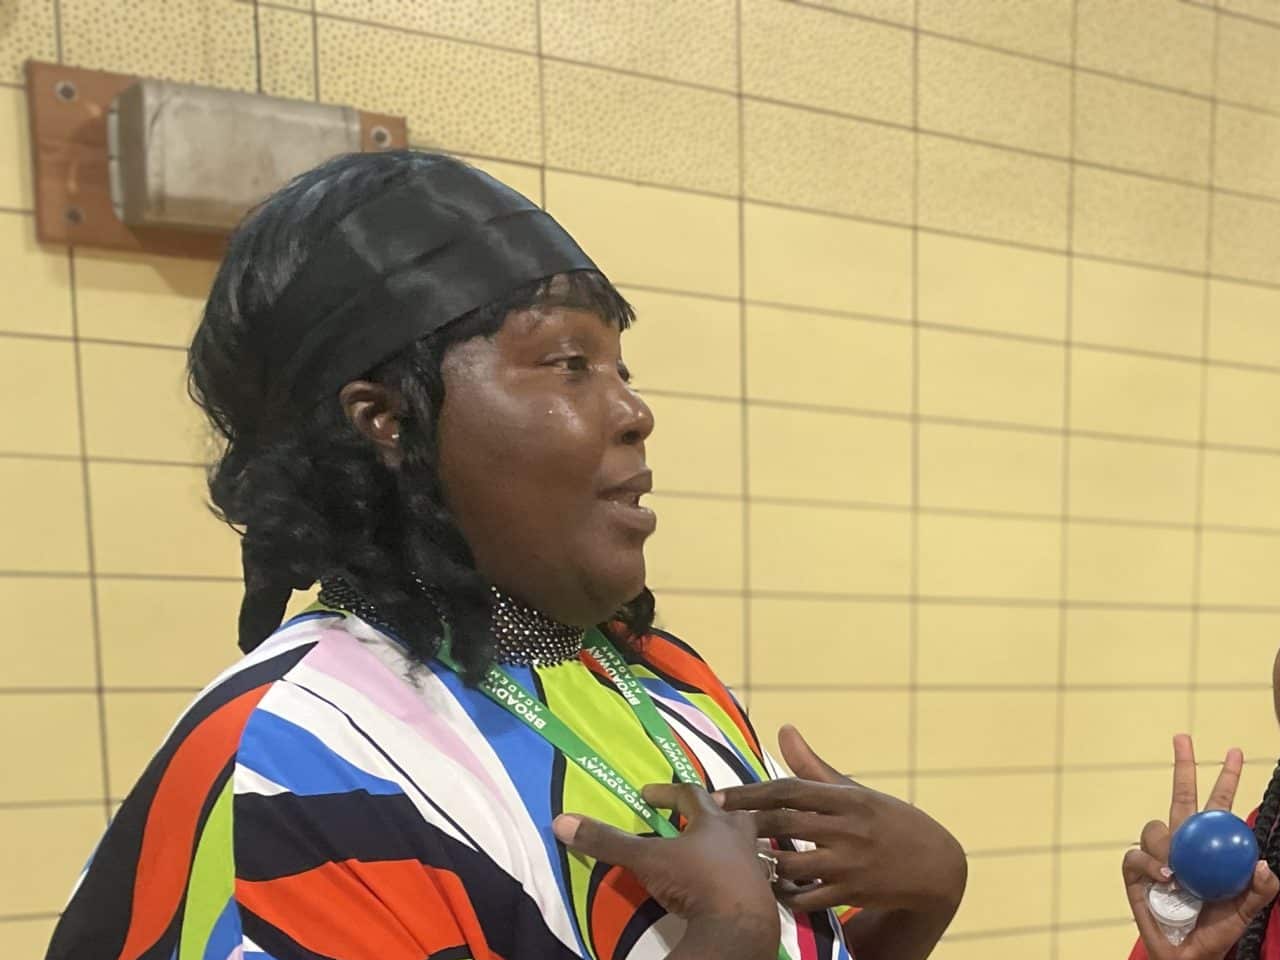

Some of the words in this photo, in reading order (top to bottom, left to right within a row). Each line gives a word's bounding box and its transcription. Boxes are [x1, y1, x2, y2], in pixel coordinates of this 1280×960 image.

[490, 668, 543, 712] ACADEM
[587, 645, 641, 707] BROADWAY
[488, 679, 547, 730] BROAD
[576, 755, 652, 820] BROADWAY
